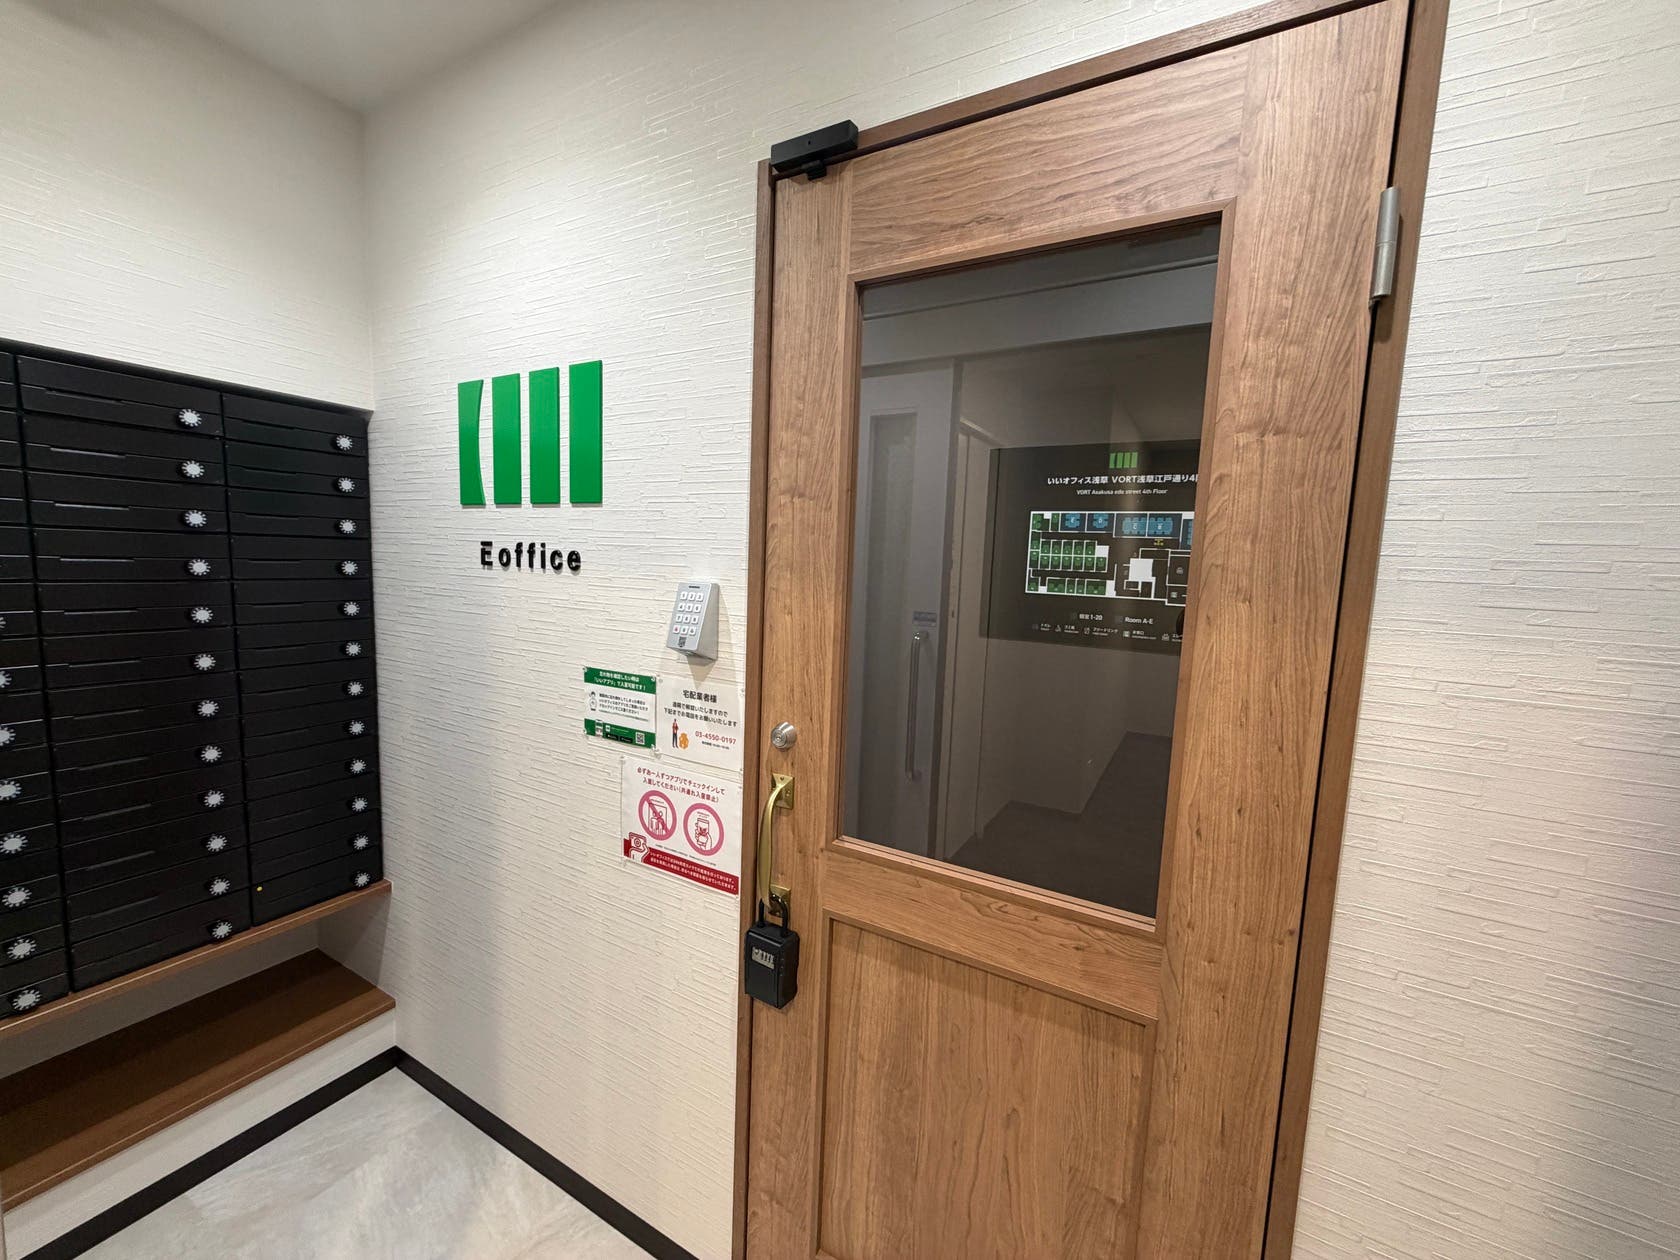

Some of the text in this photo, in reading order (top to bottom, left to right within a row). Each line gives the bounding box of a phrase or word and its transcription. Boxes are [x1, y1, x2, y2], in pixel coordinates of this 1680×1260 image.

[480, 541, 581, 571] Eoffice
[1125, 616, 1141, 624] Room
[683, 689, 717, 703] 宅配業者様
[695, 731, 736, 745] 03-4550-0197
